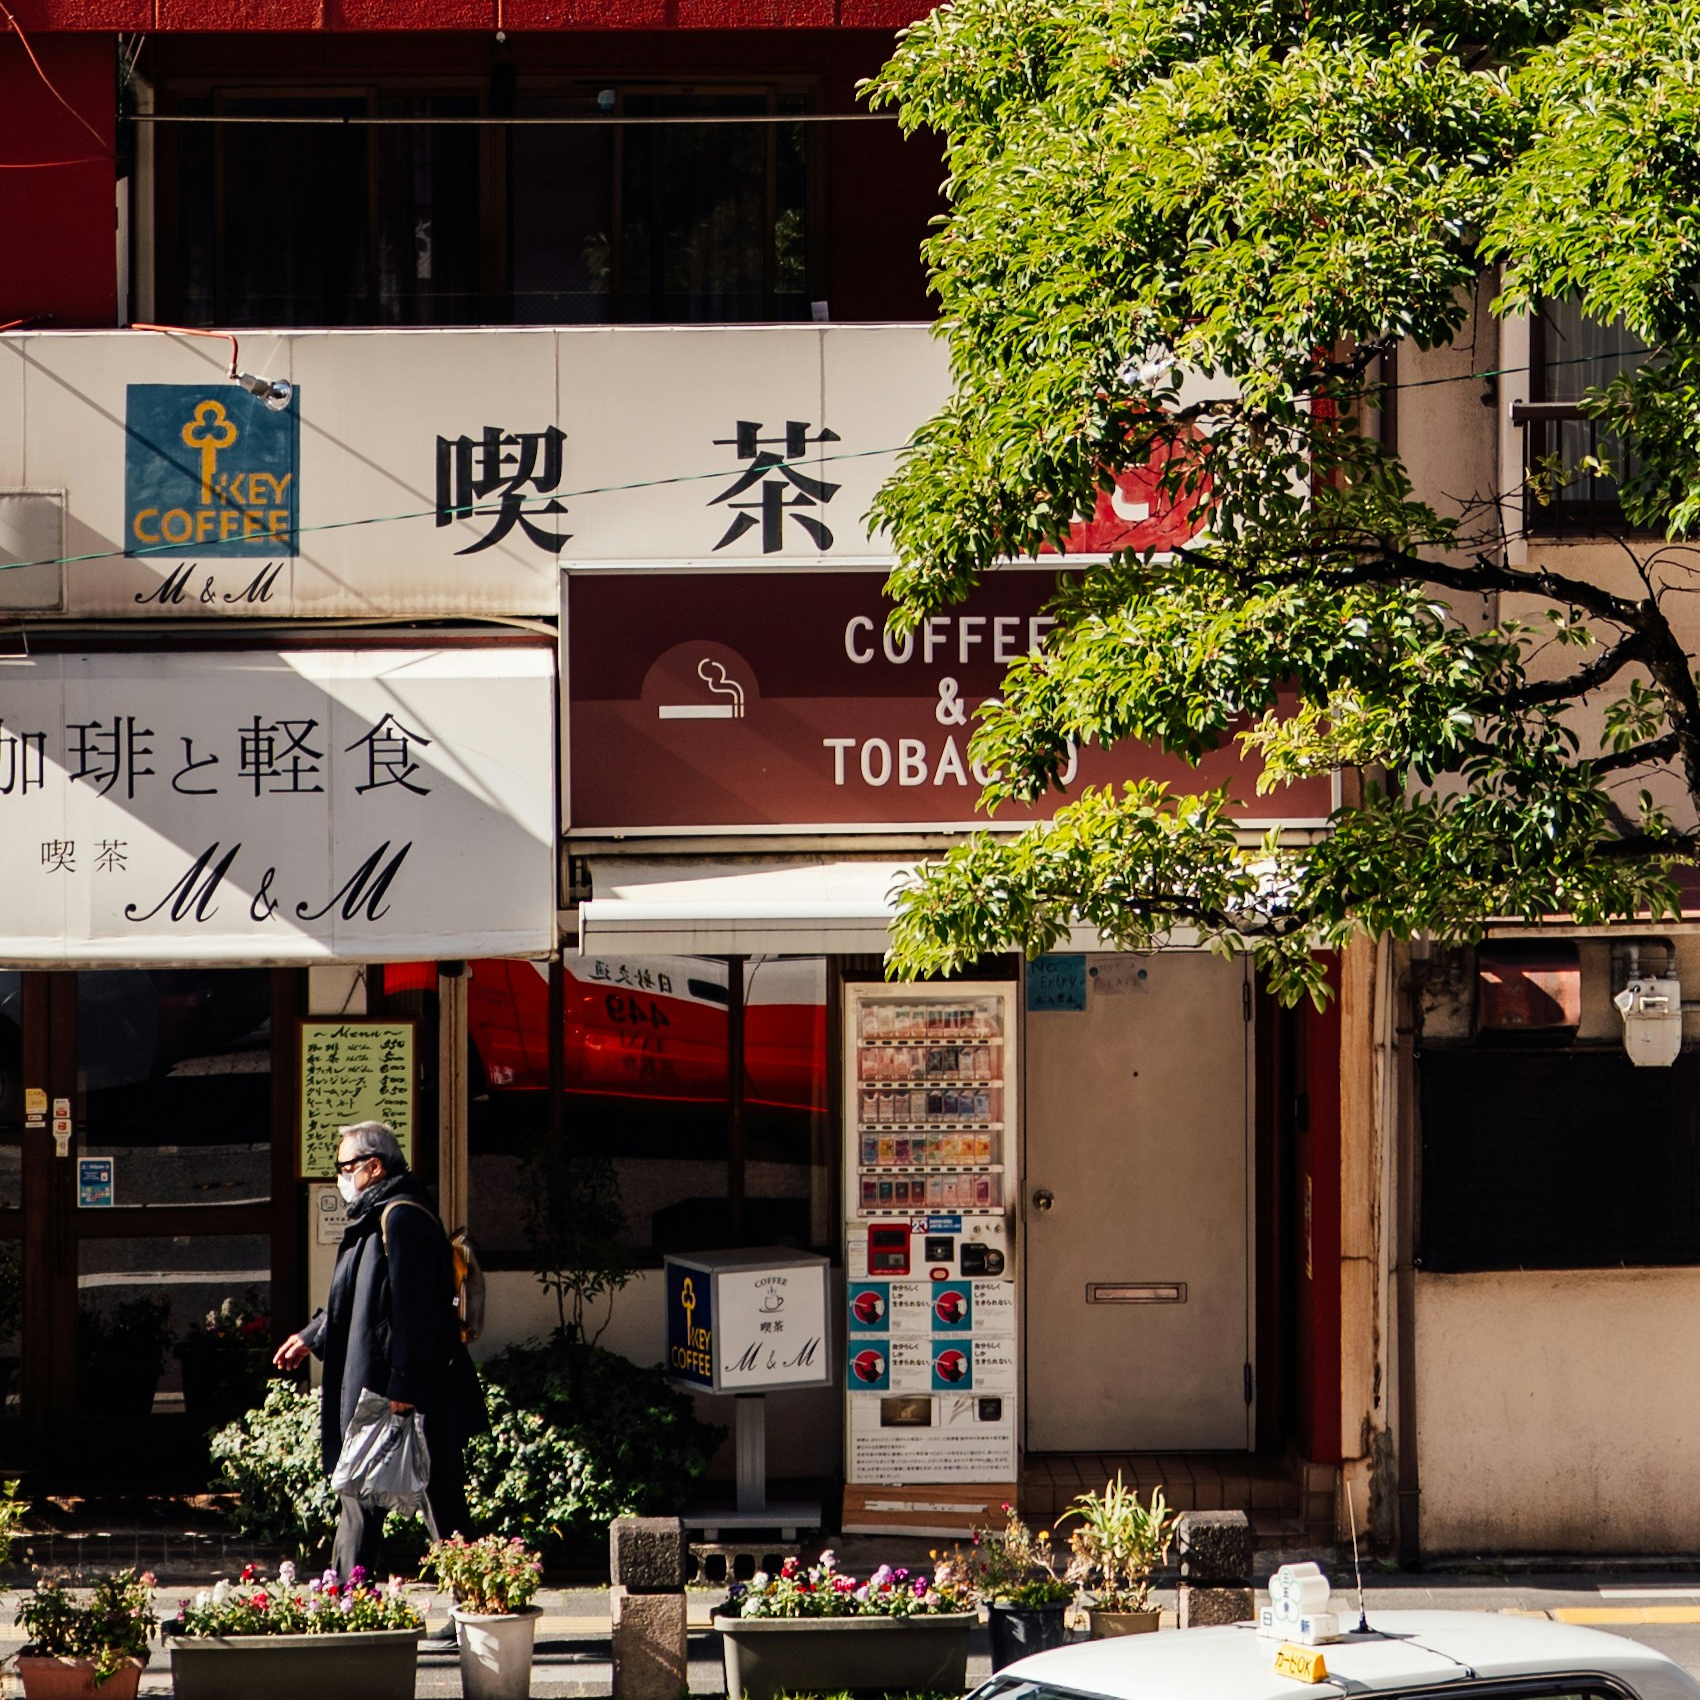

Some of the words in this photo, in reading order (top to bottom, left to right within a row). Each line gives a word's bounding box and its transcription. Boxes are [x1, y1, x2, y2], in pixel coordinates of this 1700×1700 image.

[215, 472, 291, 505] KEY
[133, 508, 290, 543] COFFEE
[134, 561, 198, 605] M
[200, 576, 216, 604] &
[223, 561, 285, 605] M
[935, 676, 967, 726] &
[41, 839, 129, 874] 喫茶
[124, 841, 242, 923] M
[250, 867, 279, 923] &
[295, 841, 413, 923] M
[754, 1276, 790, 1289] COFFEE
[892, 1292, 904, 1300] しか
[974, 1291, 986, 1299] しか
[690, 1325, 712, 1351] KEY
[974, 1350, 986, 1358] しか
[672, 1345, 712, 1377] COFFEE
[767, 1350, 776, 1370] &
